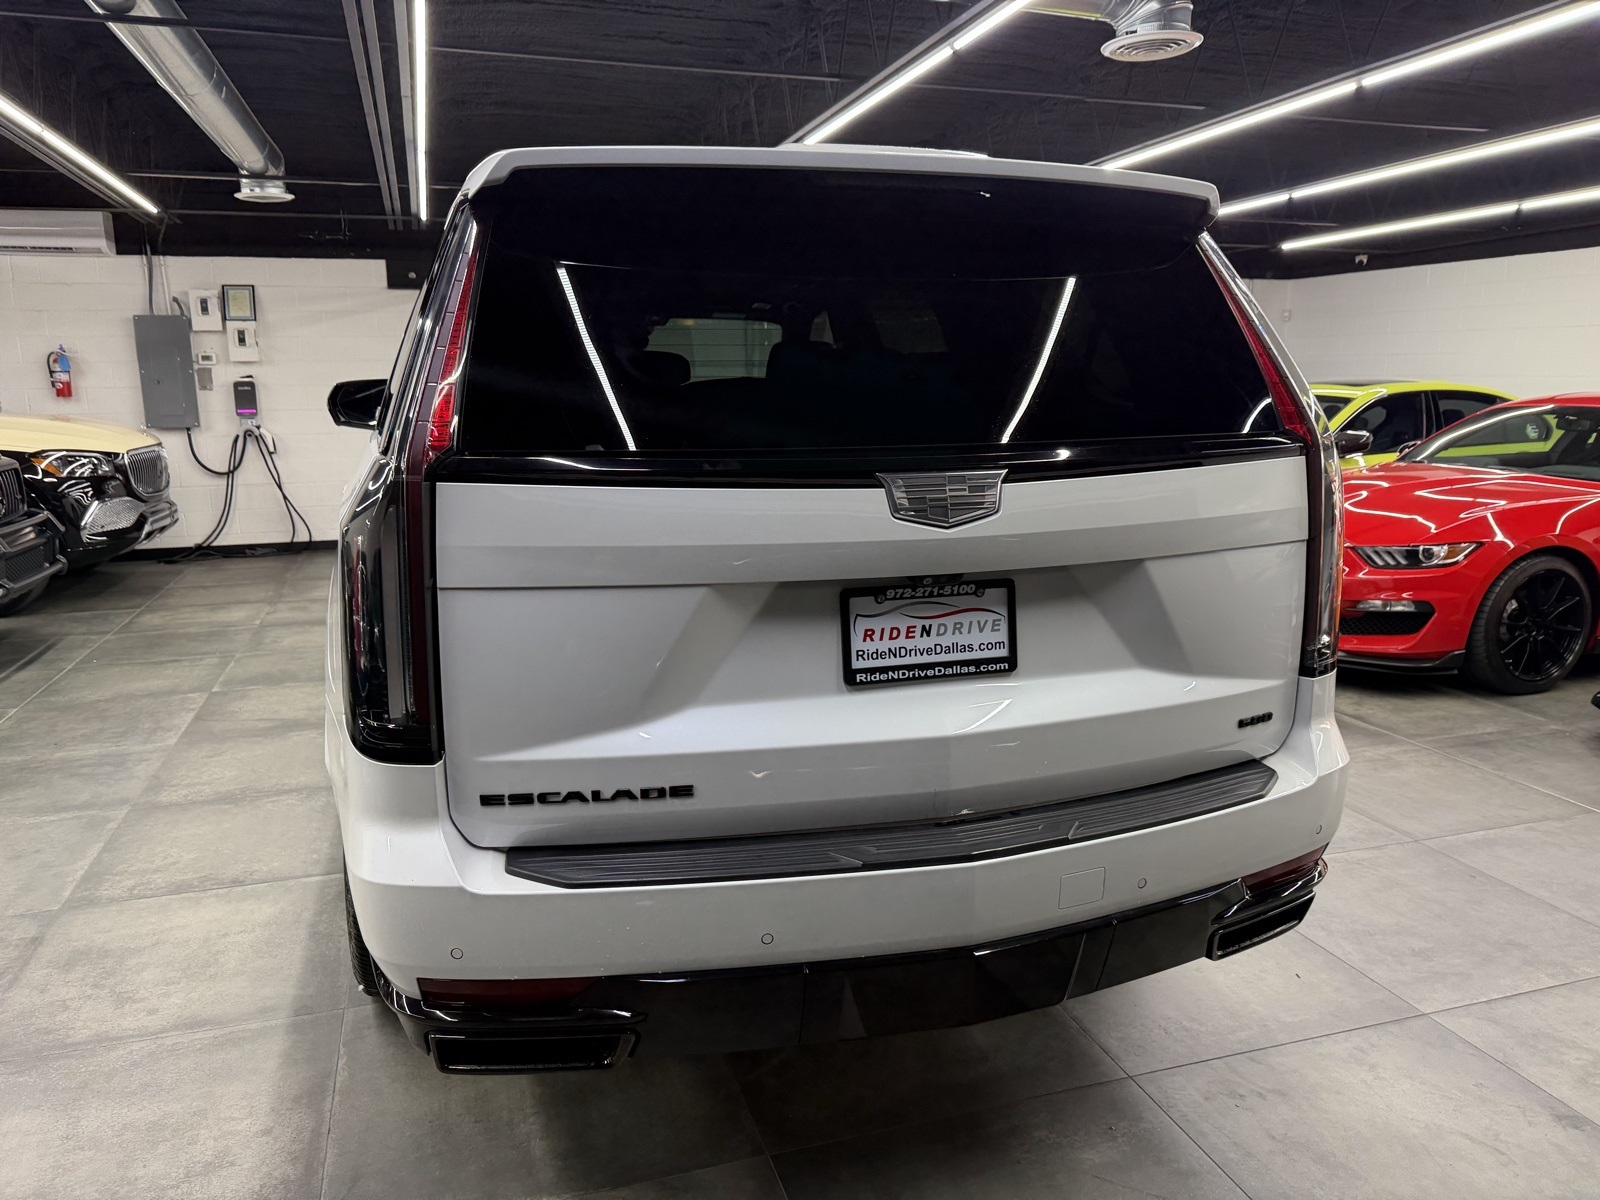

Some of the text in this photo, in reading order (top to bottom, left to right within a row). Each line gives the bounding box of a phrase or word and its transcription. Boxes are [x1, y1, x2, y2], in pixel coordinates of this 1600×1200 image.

[886, 584, 976, 599] 972-271-5100
[862, 618, 1002, 643] RIDENDRIVE
[855, 640, 1006, 662] RideNDriveDallas.com
[856, 662, 1009, 683] RideNDriveDallas.com
[479, 784, 695, 807] ESCALADE
